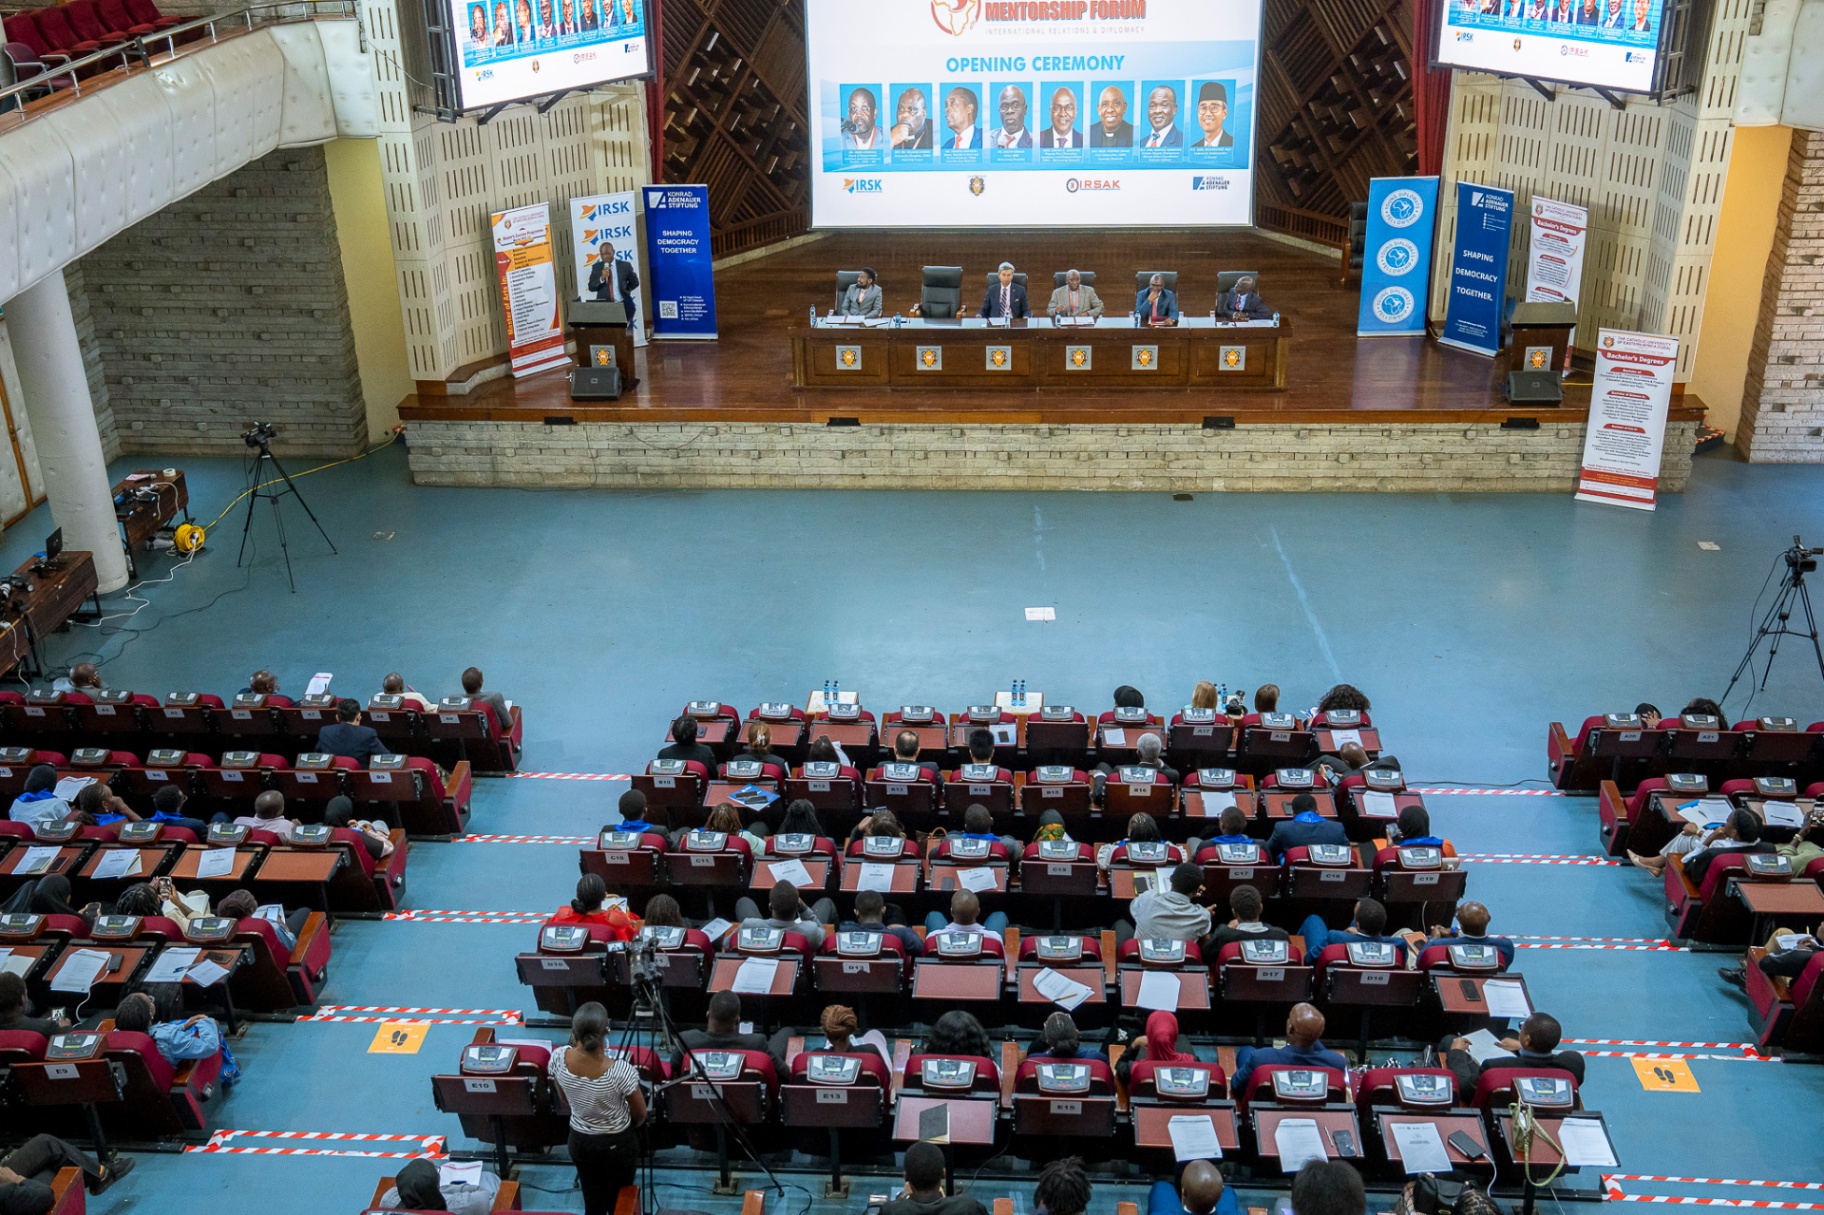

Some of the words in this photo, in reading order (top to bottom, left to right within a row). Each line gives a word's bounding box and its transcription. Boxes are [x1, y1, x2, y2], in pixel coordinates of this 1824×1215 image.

[985, 0, 1087, 21] MENTORSHIP
[1089, 0, 1146, 20] FORUM
[985, 28, 1045, 36] INTERNATIONAL
[946, 57, 1026, 72] OPENING
[1032, 56, 1125, 71] CEREMONY
[856, 179, 882, 190] IRSK
[1080, 180, 1120, 188] IRSAK
[1385, 194, 1397, 210] YOUNG
[1398, 192, 1420, 208] DIPLOMATS
[1486, 199, 1508, 207] ADENAUER
[598, 201, 629, 216] IRSK
[1485, 204, 1506, 212] STIFTUNG
[1386, 214, 1417, 225] FELLOWSHIP
[600, 226, 631, 239] IRSK
[1538, 220, 1559, 230] Bachelor's
[1560, 225, 1576, 235] Degrees
[615, 250, 633, 260] SK
[1381, 243, 1393, 258] YOUNG
[1394, 241, 1415, 258] DIPLOMATS
[1463, 250, 1494, 262] SHAPING
[1382, 262, 1413, 273] FELLOWSHIP
[1456, 268, 1497, 282] DEMOCRACY
[1456, 286, 1493, 301] TOGETHER.
[1607, 352, 1638, 361] Bachelor's
[1640, 356, 1664, 364] Degrees
